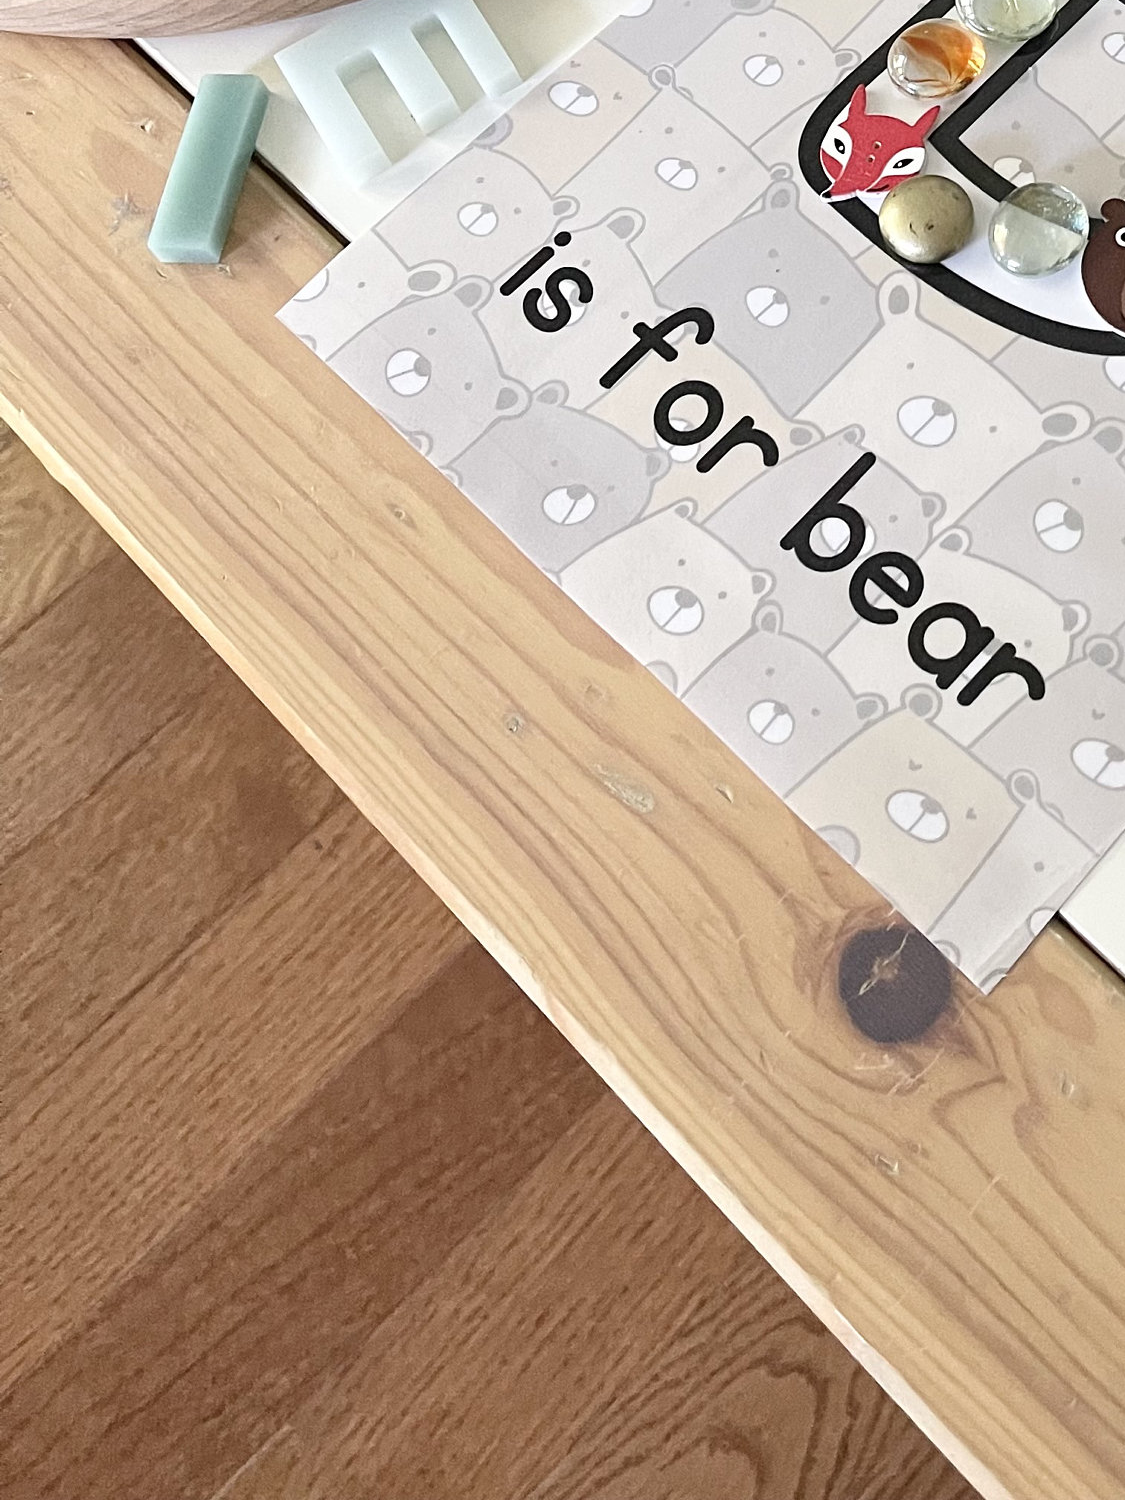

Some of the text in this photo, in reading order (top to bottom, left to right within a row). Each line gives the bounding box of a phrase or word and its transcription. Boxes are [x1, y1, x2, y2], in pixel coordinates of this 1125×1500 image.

[499, 231, 1047, 707] is for bear
